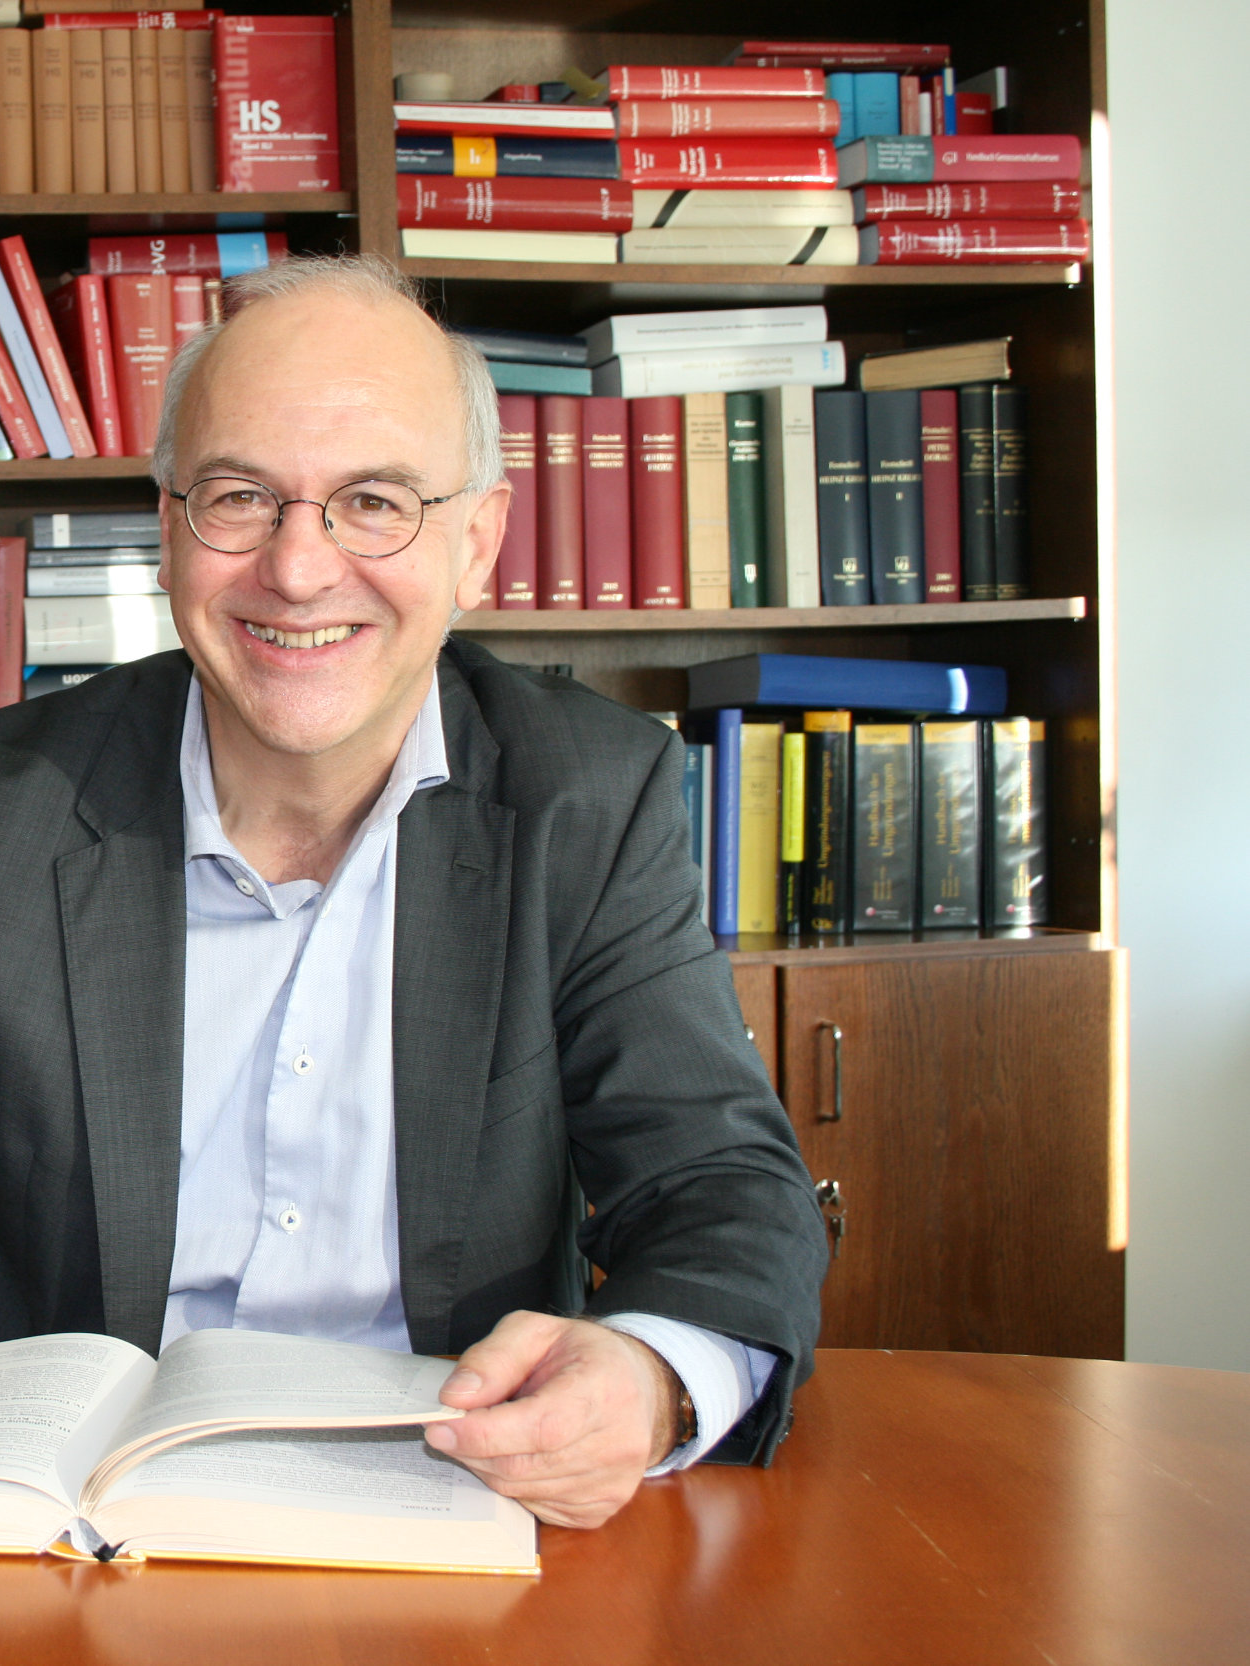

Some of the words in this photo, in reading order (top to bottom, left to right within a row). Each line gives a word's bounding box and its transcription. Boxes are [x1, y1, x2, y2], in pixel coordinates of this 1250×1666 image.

[239, 100, 281, 132] HS
[868, 772, 880, 789] der
[868, 790, 880, 847] Handbuch
[881, 762, 896, 857] Umgründungen
[935, 789, 947, 846] Handbuch
